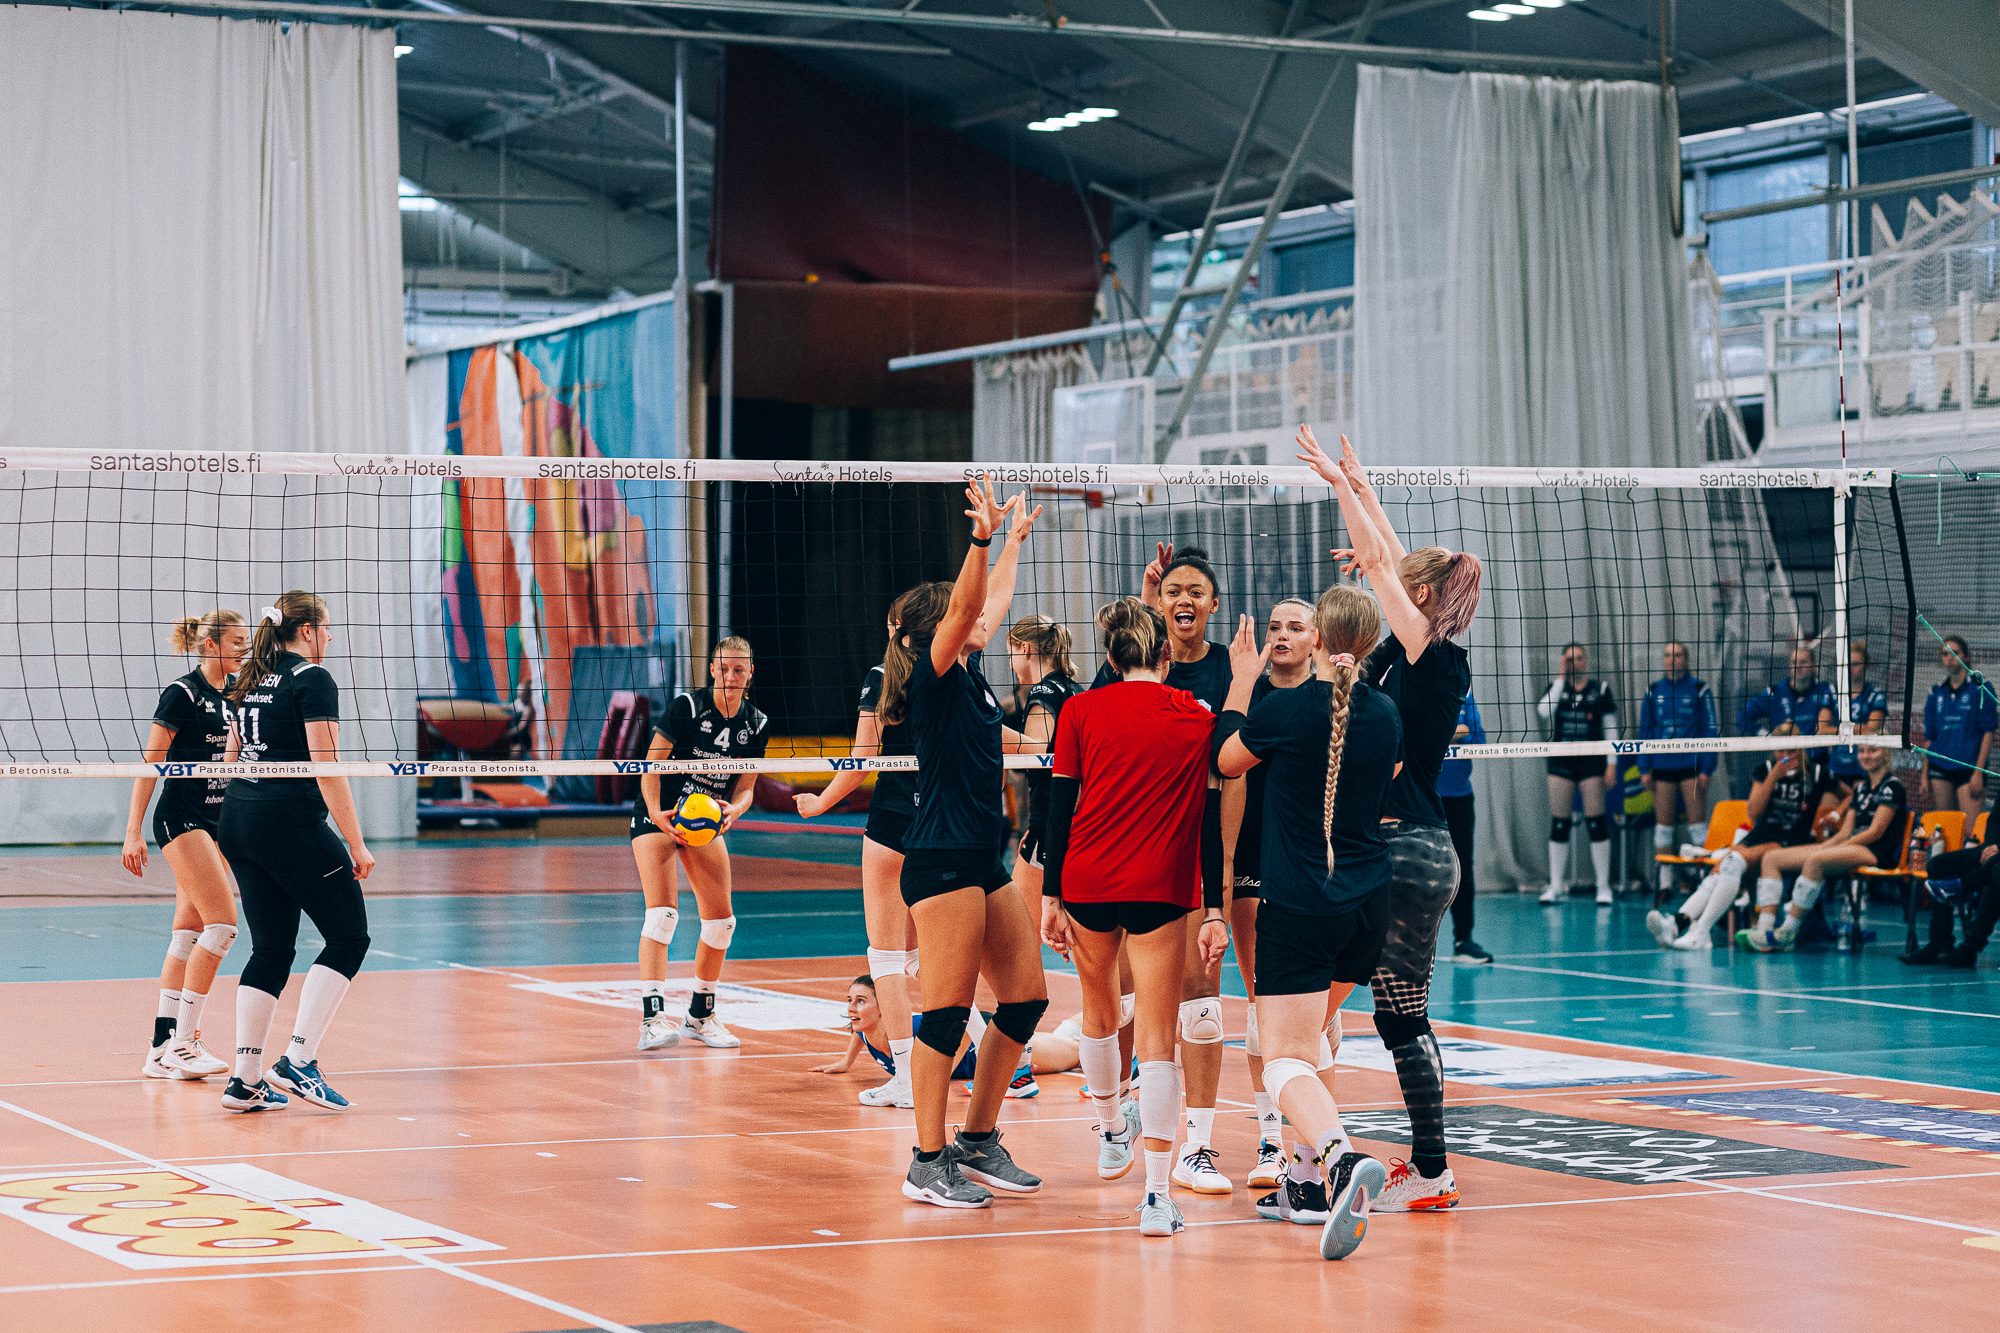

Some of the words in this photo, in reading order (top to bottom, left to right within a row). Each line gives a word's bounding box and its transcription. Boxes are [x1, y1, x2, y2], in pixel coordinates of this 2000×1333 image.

[90, 452, 261, 473] santashotels.fi
[404, 461, 462, 477] Hotels
[538, 460, 696, 480] santashotels.fi
[839, 467, 893, 482] Hotels
[1219, 471, 1269, 486] Hotels
[1366, 468, 1470, 486] tashotels.fi
[1592, 474, 1640, 488] Hotels
[1699, 470, 1820, 489] santashotels.f
[238, 707, 260, 745] 11
[714, 727, 730, 749] 4
[1463, 748, 1500, 756] Parasta
[1611, 741, 1644, 753] YBT
[9, 766, 73, 775] Betonista.
[154, 764, 197, 776] YBT
[199, 766, 246, 775] Parasta
[250, 766, 311, 775] Betonista.
[388, 763, 430, 775] YBT
[431, 764, 476, 773] Parasta
[480, 763, 539, 773] Betonista.
[612, 761, 653, 774] YBT
[653, 762, 699, 772] Parata
[702, 763, 758, 771] Betonista.
[828, 758, 867, 770] YBT
[868, 760, 910, 768] Parasta
[1780, 783, 1800, 800] 15
